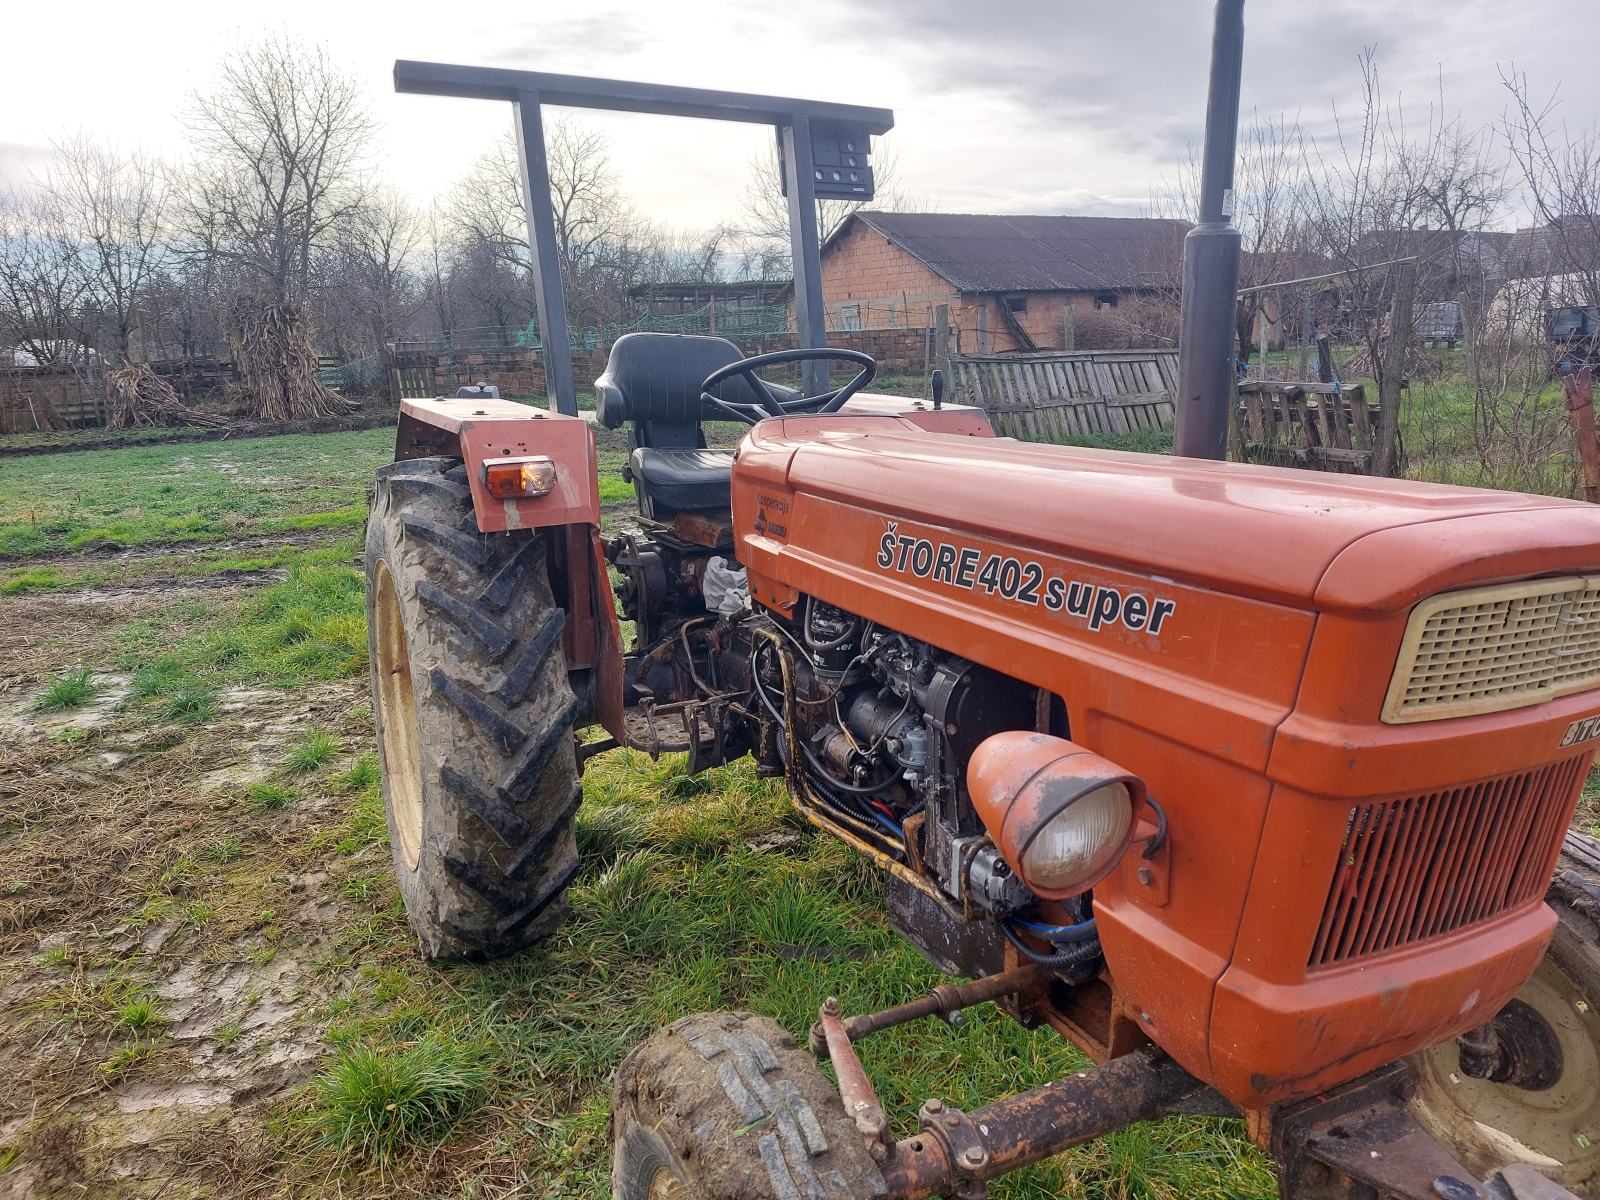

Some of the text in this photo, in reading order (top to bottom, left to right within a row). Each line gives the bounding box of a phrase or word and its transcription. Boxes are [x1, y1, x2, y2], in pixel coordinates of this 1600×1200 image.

[877, 521, 1176, 636] ŠTORE 402 super
